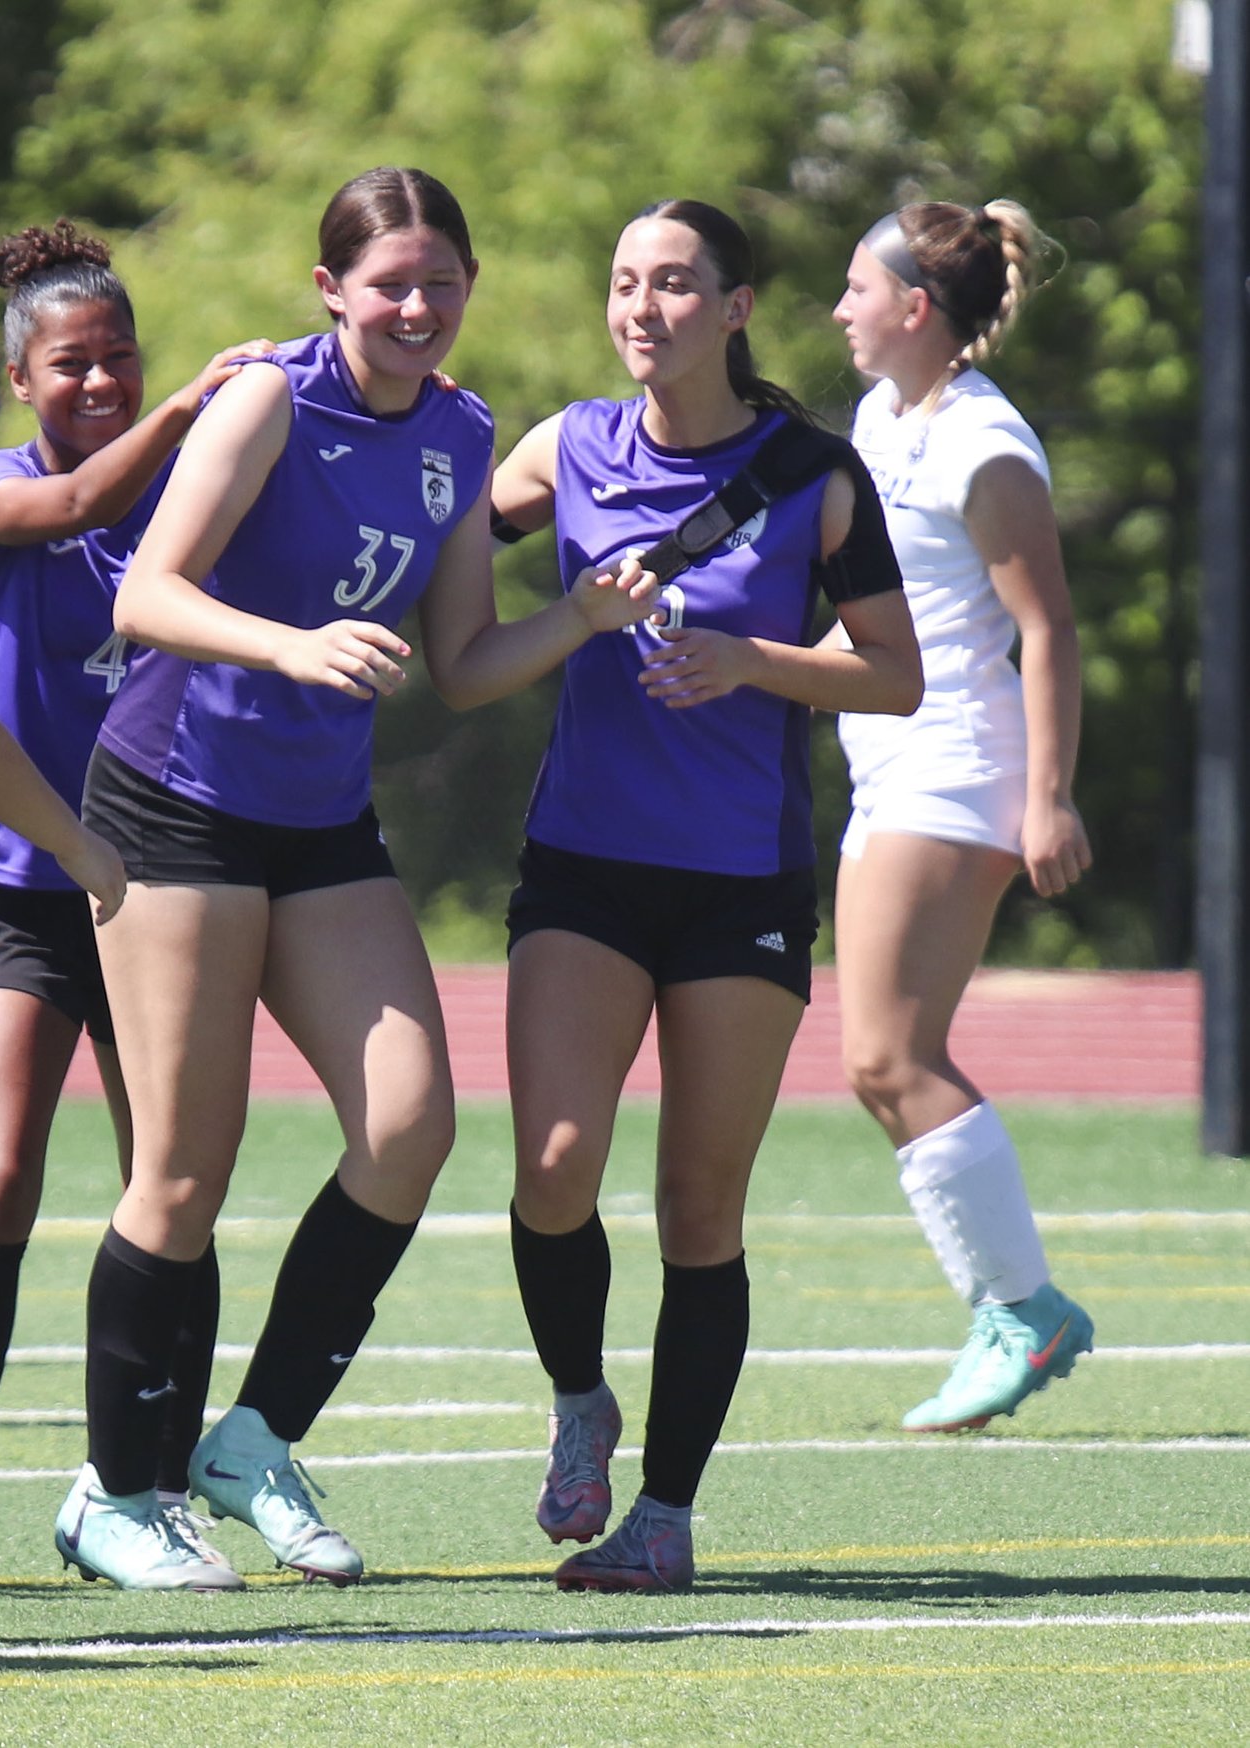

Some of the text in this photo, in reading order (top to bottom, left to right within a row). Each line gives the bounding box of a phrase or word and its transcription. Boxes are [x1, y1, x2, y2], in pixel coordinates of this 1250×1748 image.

[429, 501, 448, 521] PHS
[333, 524, 415, 611] 37
[83, 630, 127, 694] 4
